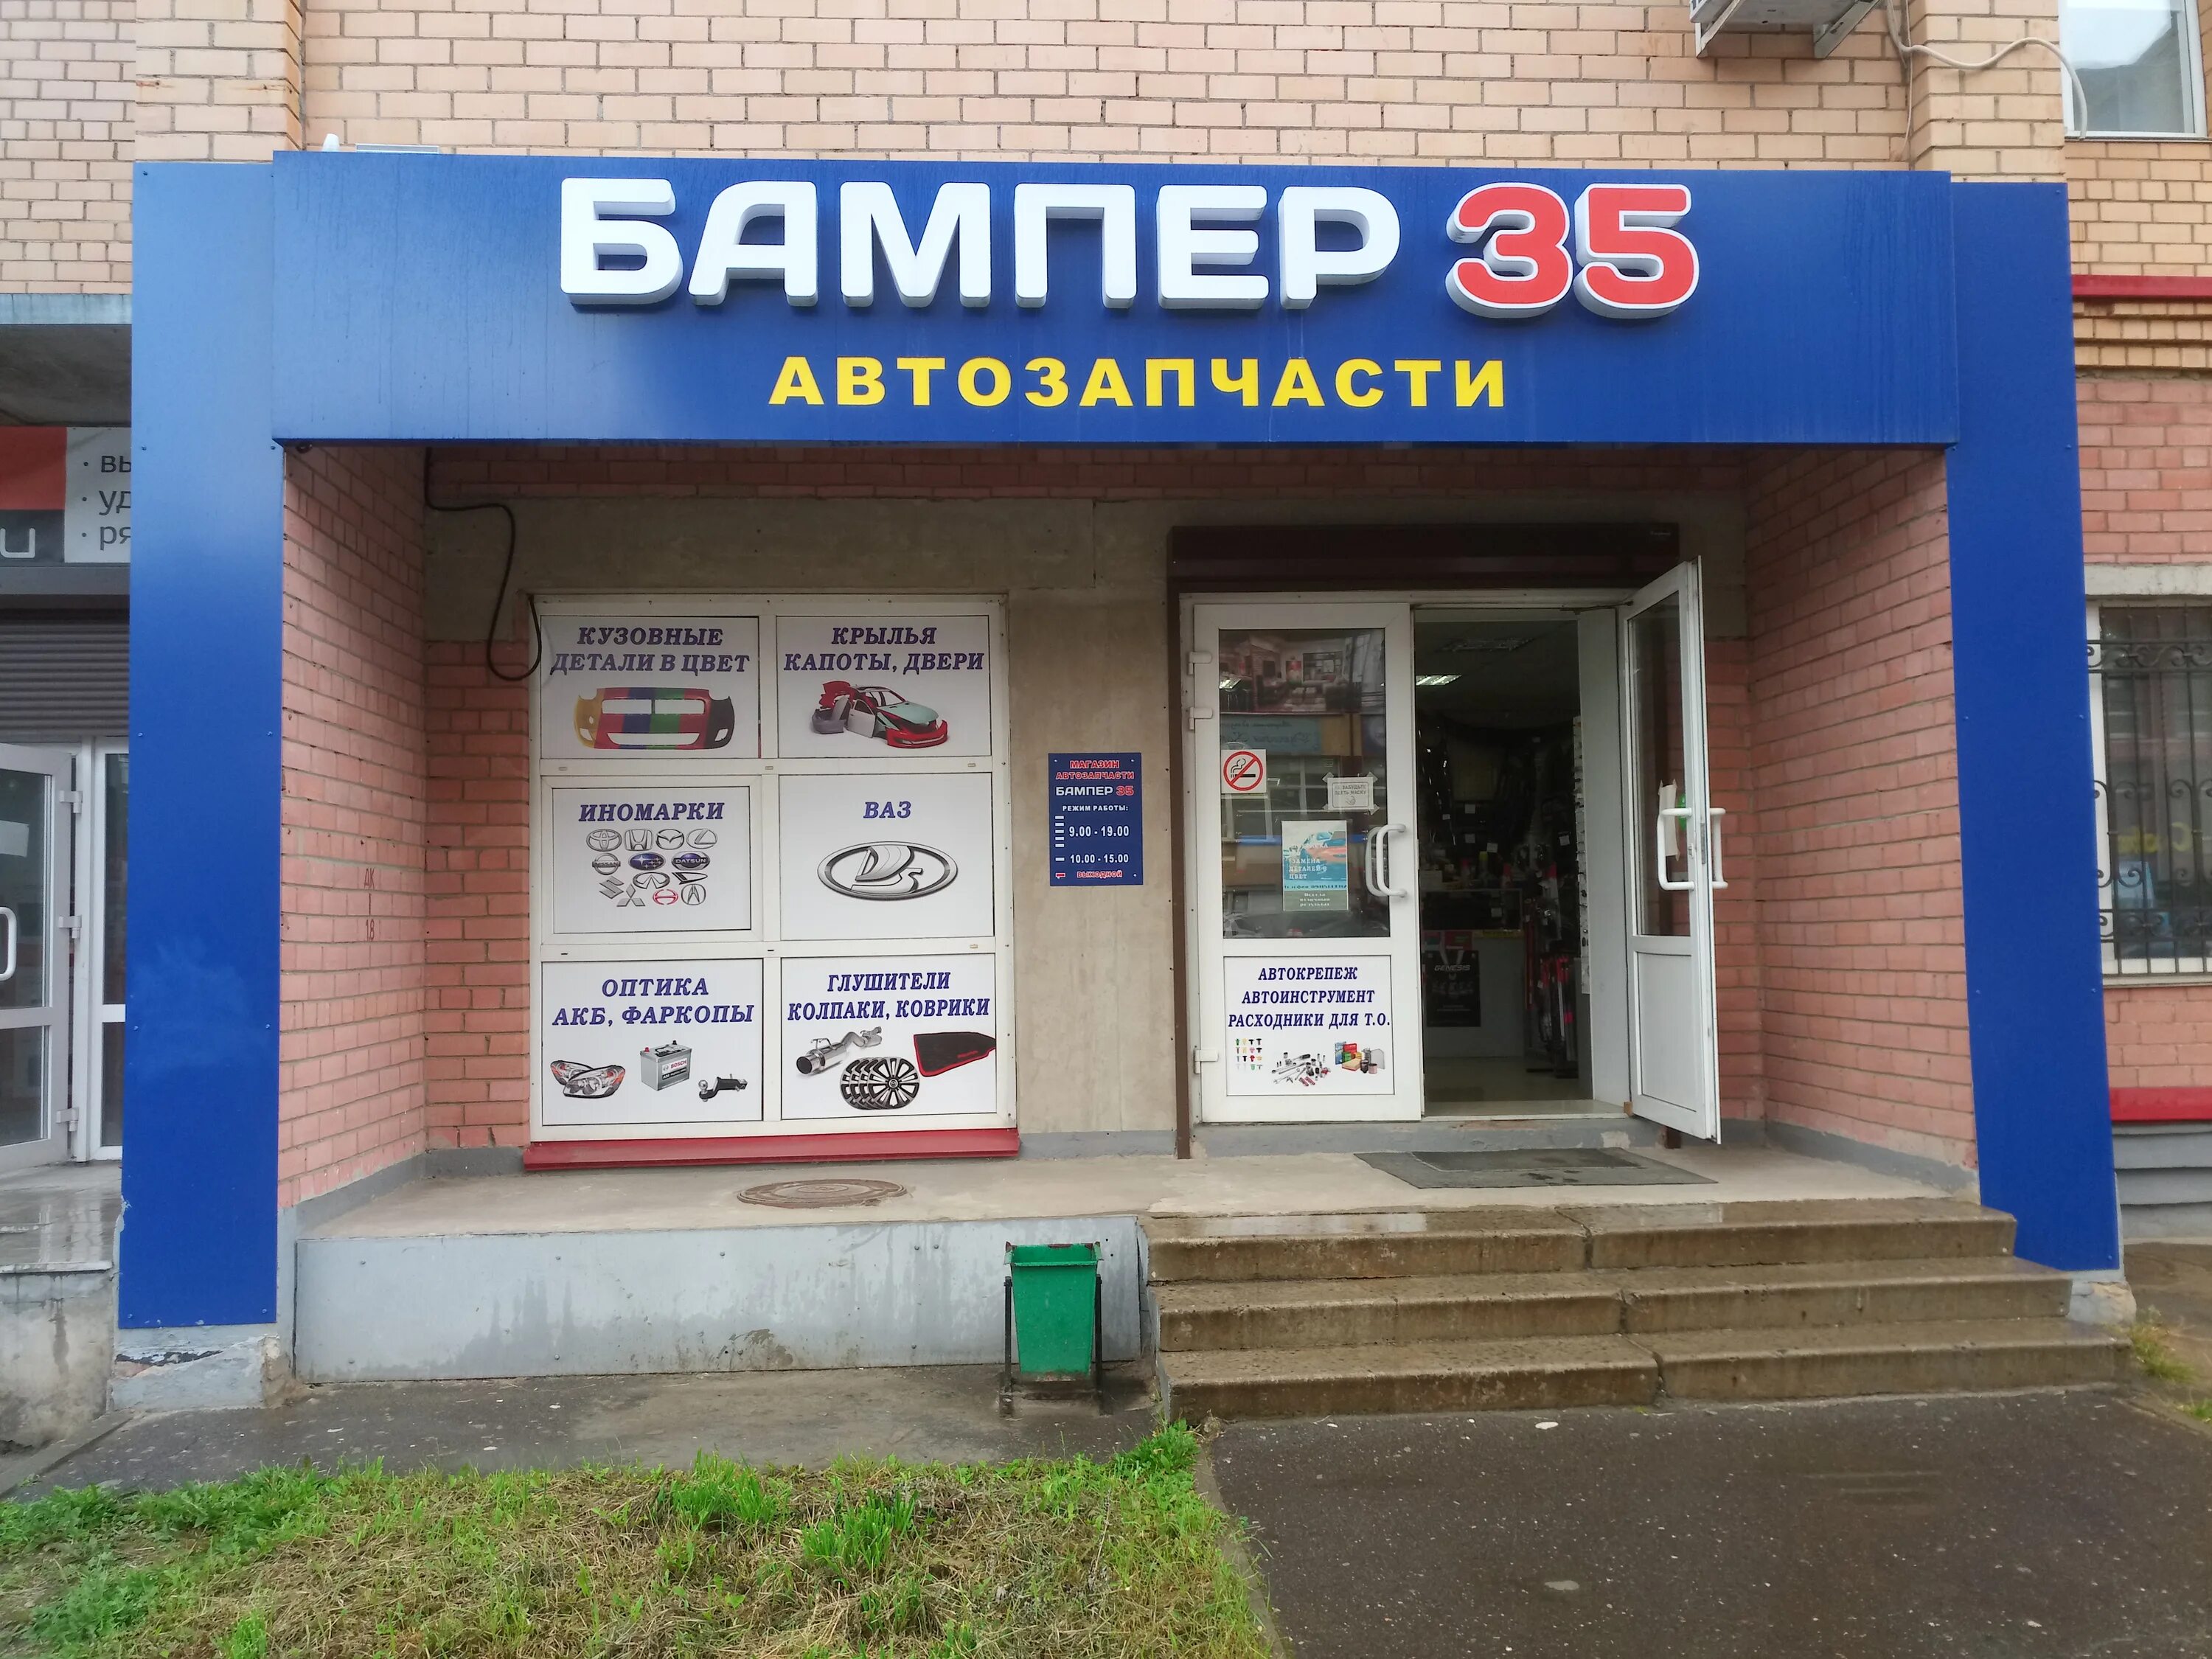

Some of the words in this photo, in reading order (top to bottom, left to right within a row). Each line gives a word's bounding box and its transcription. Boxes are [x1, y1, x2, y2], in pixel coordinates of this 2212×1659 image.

[561, 178, 1400, 310] БАМПЕР
[1445, 182, 1700, 319] 35
[768, 355, 1506, 408] АВТОЗАПЧАСТИ
[577, 627, 723, 646] КУЗОВНЫЕ
[831, 627, 937, 644] КРЫЛЬЯ
[549, 653, 655, 675] ДЕТАЛИ
[658, 654, 675, 672] В
[681, 654, 751, 676] ЦВЕТ
[783, 653, 897, 672] КАПОТЫ,
[902, 653, 985, 675] ДВЕРИ
[1070, 760, 1120, 769] МАГАЗИН
[1056, 771, 1135, 780] АВТОЗАПЧАСТИ
[1056, 786, 1113, 796] БАМПЕР
[1116, 785, 1135, 796] 35
[578, 802, 726, 822] ИНОМАРКИ
[863, 801, 912, 818] ВАЗ
[1069, 826, 1091, 837] 9.00
[1101, 826, 1130, 837] 19.00
[1070, 855, 1096, 863] 10.00
[1103, 854, 1129, 863] 15.00
[1077, 869, 1123, 878] ВЫХОДНОЙ
[827, 973, 950, 992] ГЛУШИТЕЛИ
[1258, 967, 1358, 981] АВТОКРЕПЕЖ
[602, 978, 709, 997] ОПТИКА
[1242, 990, 1375, 1004] АВТОИНСТРУМЕНТ
[552, 1007, 613, 1026] АКБ,
[622, 1005, 754, 1024] ФАРКОПЫ
[787, 1001, 890, 1020] КОЛПАКИ,
[895, 998, 990, 1018] КОВРИКИ
[1228, 1013, 1324, 1030] РАСХОДНИКИ
[1329, 1013, 1359, 1029] ДЛЯ
[1364, 1012, 1391, 1026] Т.О.
[671, 1060, 686, 1069] BOSCH
